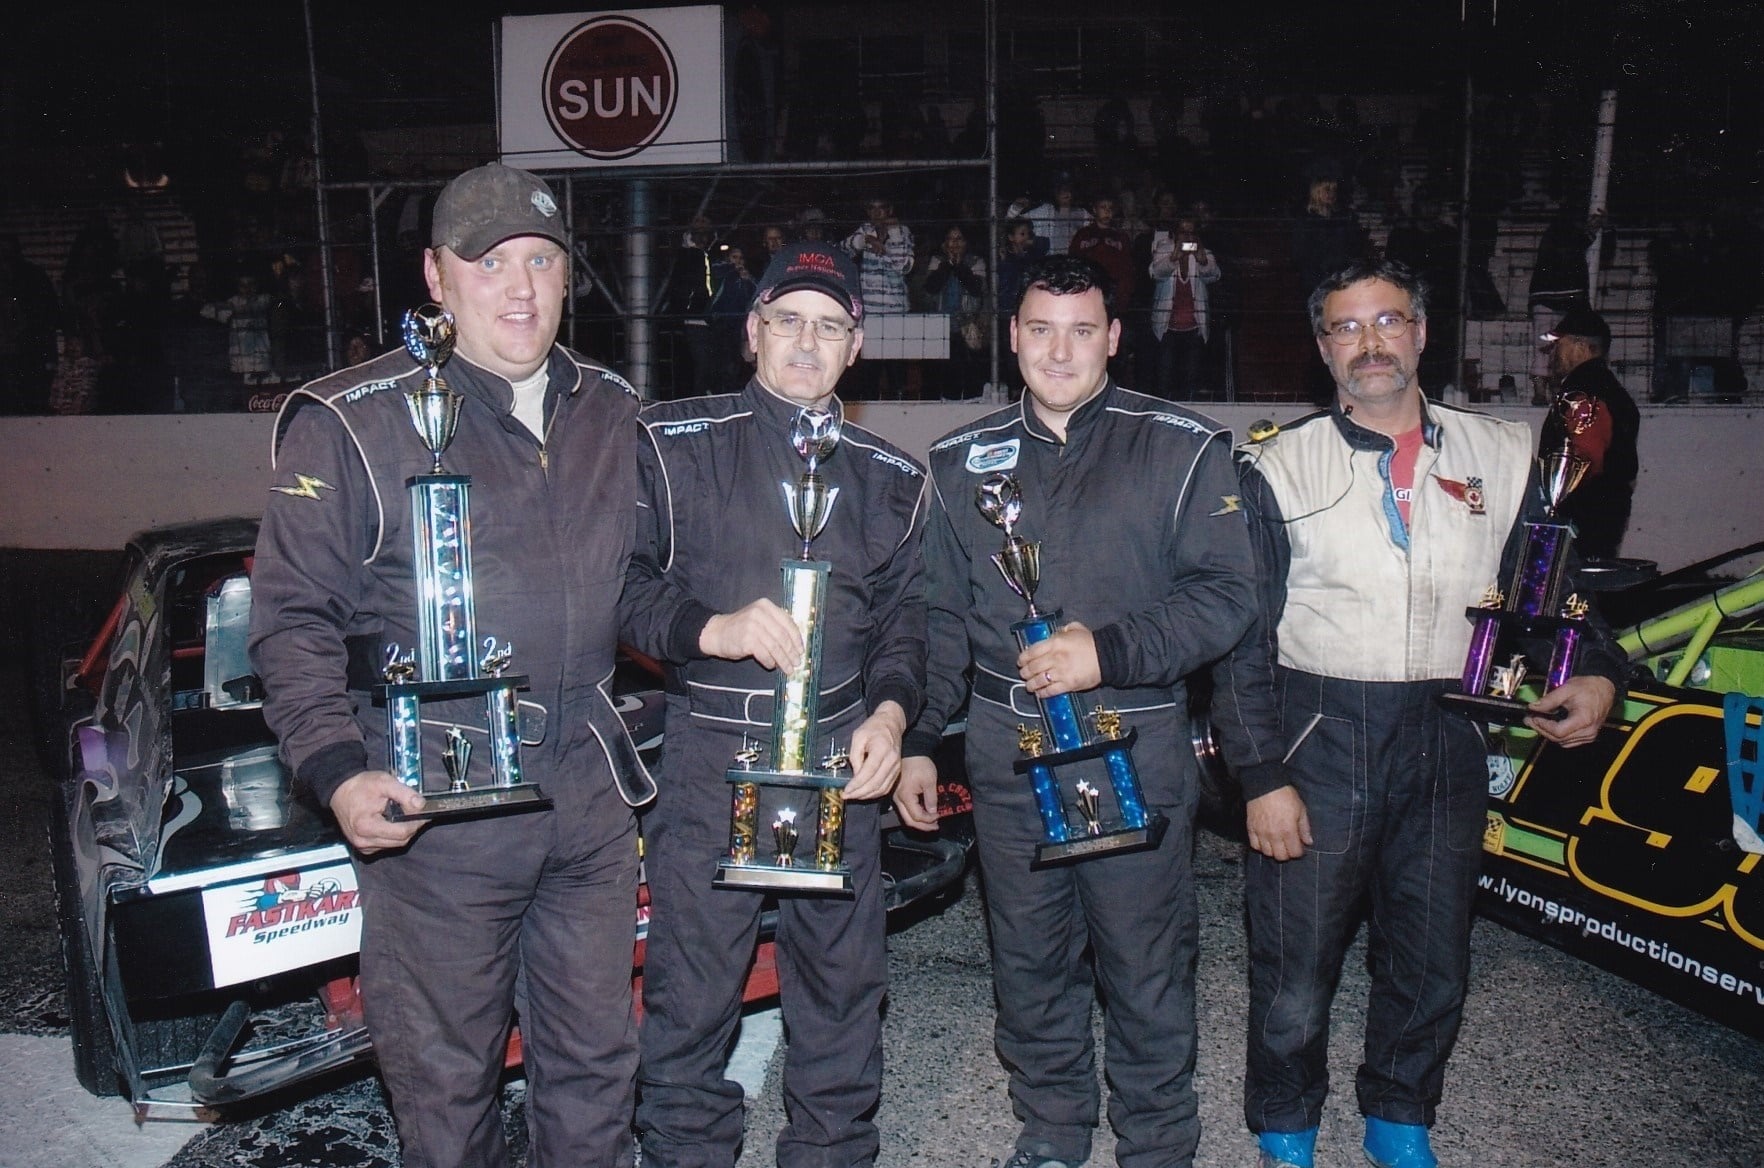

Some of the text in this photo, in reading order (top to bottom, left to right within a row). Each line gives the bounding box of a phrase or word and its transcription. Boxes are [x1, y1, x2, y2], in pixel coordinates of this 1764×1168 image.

[558, 75, 661, 120] SUN
[346, 380, 397, 403] IMPACT
[664, 422, 710, 436] IMPACT
[872, 452, 920, 478] IMPACT
[1566, 593, 1589, 611] 4th
[383, 642, 416, 672] 2nd
[480, 636, 512, 666] 2nd
[225, 889, 361, 938] FASTKAR
[253, 912, 350, 944] Speedway
